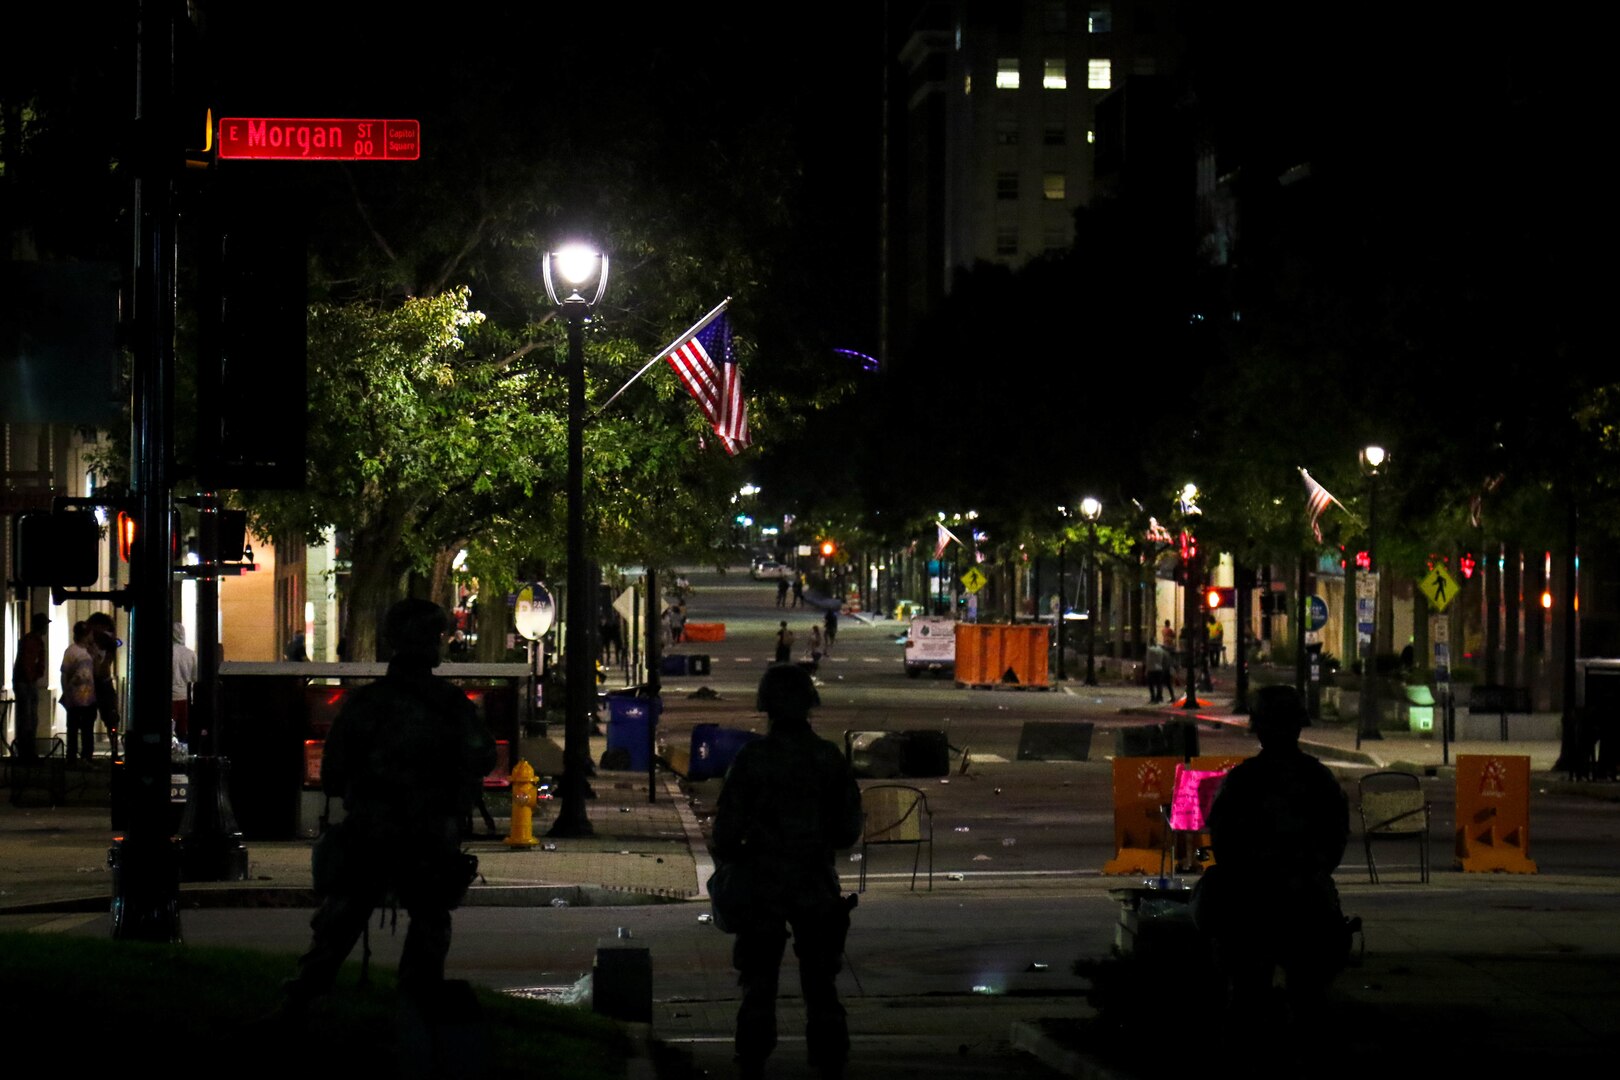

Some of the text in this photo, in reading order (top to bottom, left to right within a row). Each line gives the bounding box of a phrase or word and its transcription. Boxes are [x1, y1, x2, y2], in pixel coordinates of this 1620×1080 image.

[230, 121, 373, 155] E Morgan ST
[389, 129, 415, 139] Capitol
[354, 141, 373, 155] 00
[389, 141, 415, 151] Square
